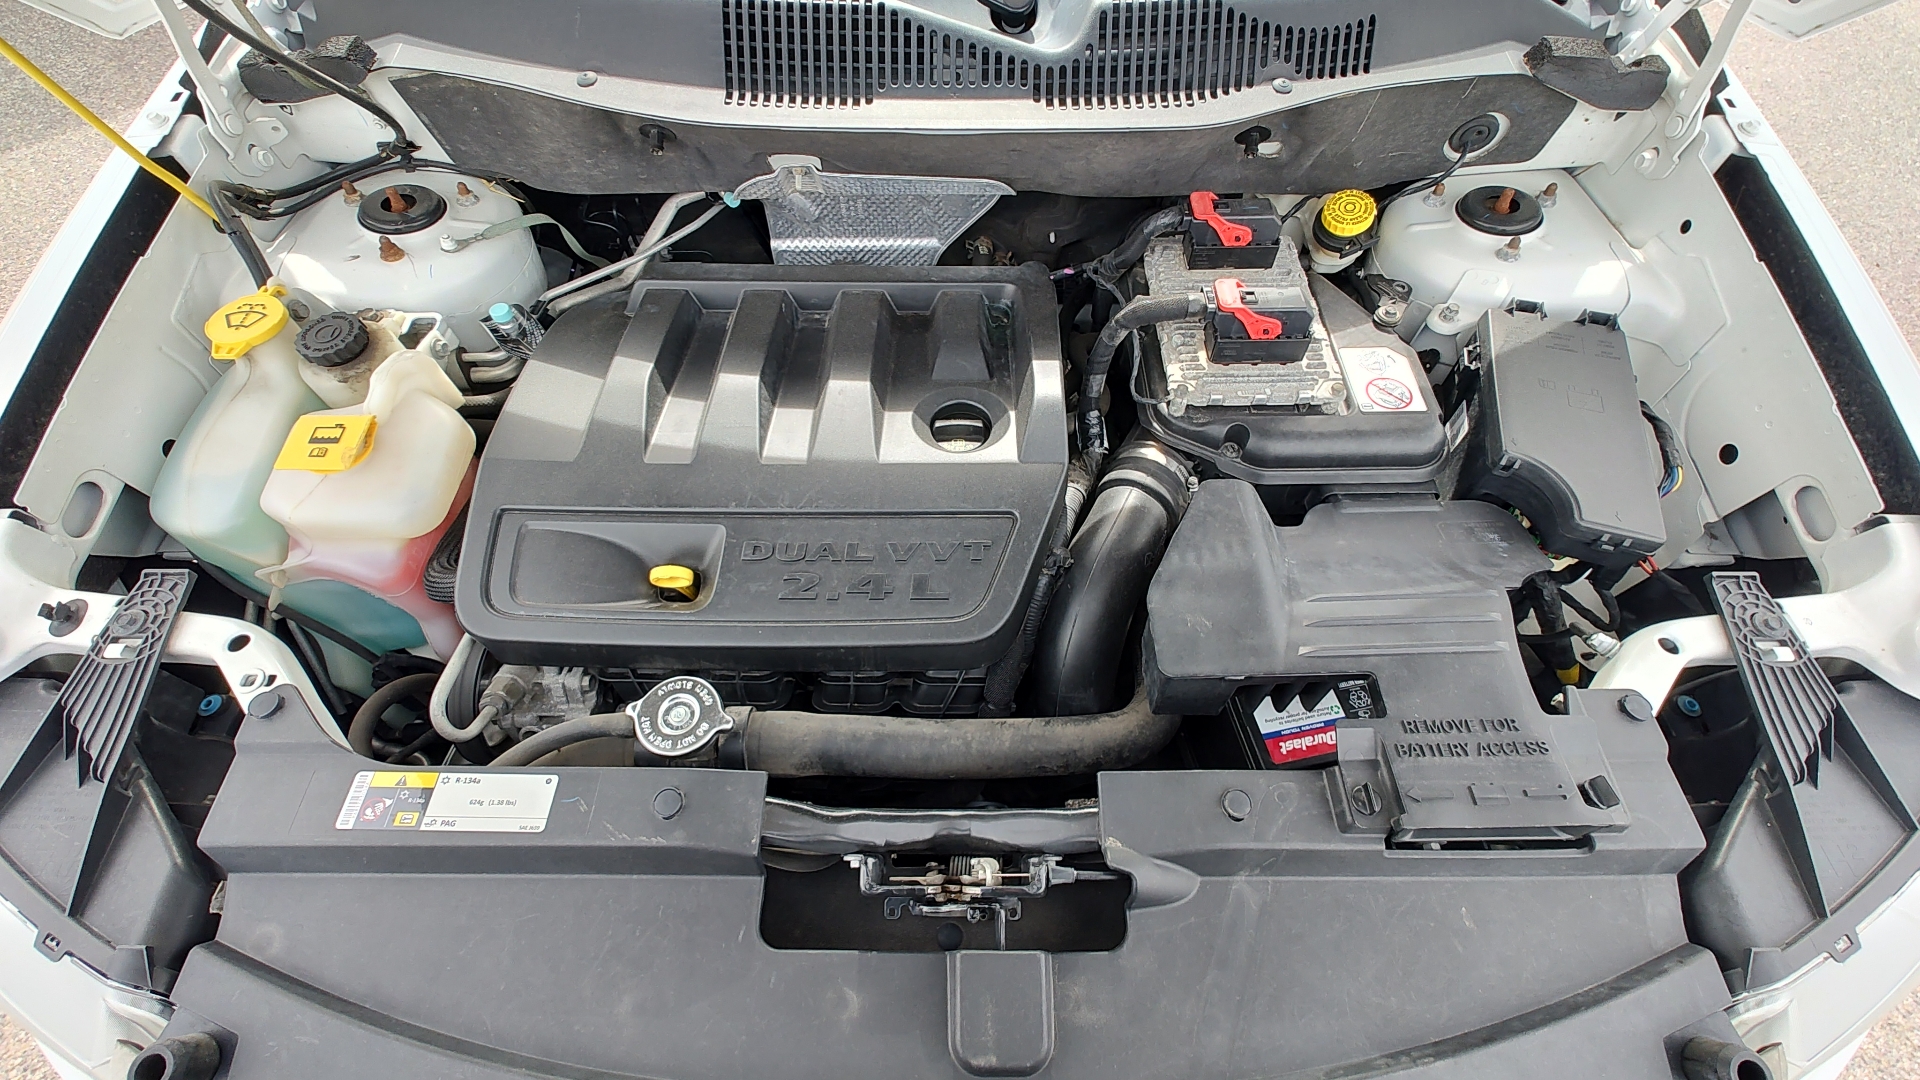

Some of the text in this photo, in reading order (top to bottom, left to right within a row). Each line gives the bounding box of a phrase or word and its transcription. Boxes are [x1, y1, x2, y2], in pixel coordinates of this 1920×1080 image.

[741, 539, 992, 563] DUAL VVT
[778, 573, 950, 601] 2.4 L
[657, 681, 713, 706] OPEN SLOWLY
[641, 716, 653, 735] HOT
[696, 722, 710, 736] DO
[1281, 722, 1325, 735] PROVEN TOUGH
[1401, 718, 1521, 734] REMOVE FOR
[648, 732, 673, 749] OPEN
[676, 734, 697, 749] NOT
[1279, 731, 1336, 755] Duralast
[1394, 740, 1550, 758] BATTERY ACCESS
